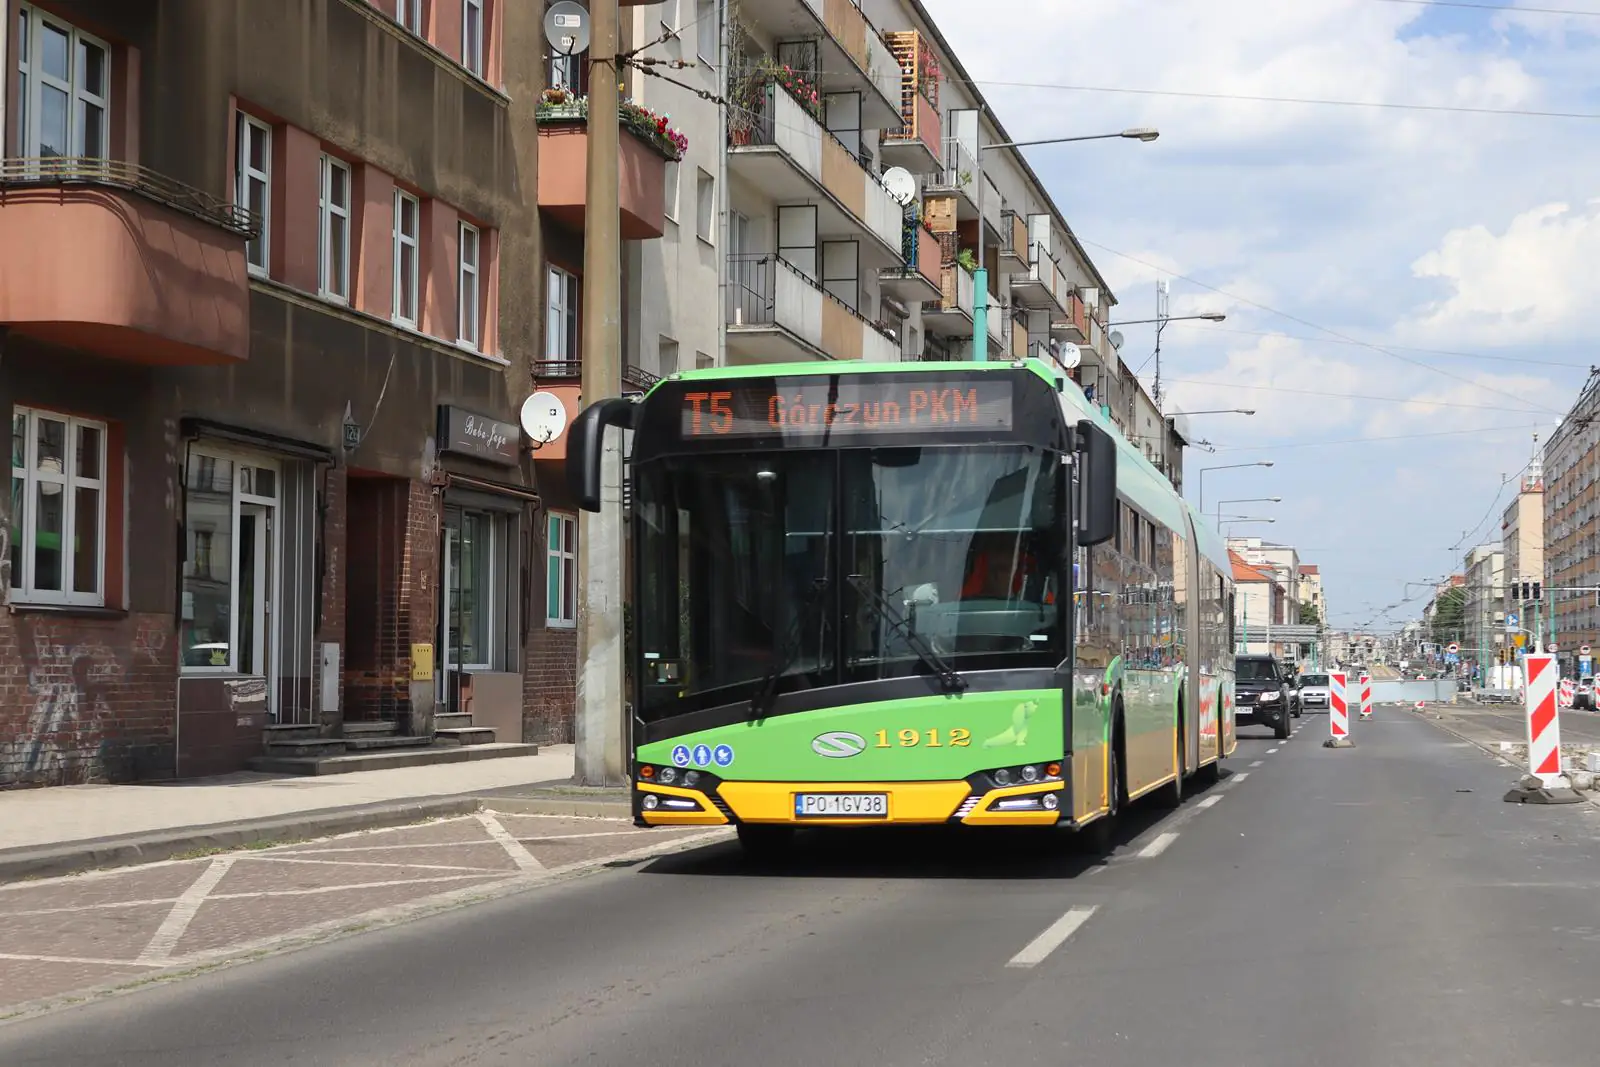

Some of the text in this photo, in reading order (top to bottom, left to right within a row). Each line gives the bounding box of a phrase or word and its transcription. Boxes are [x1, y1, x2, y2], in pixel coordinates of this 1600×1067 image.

[684, 388, 978, 435] T5 Górczyn PKM
[874, 728, 972, 748] 1912
